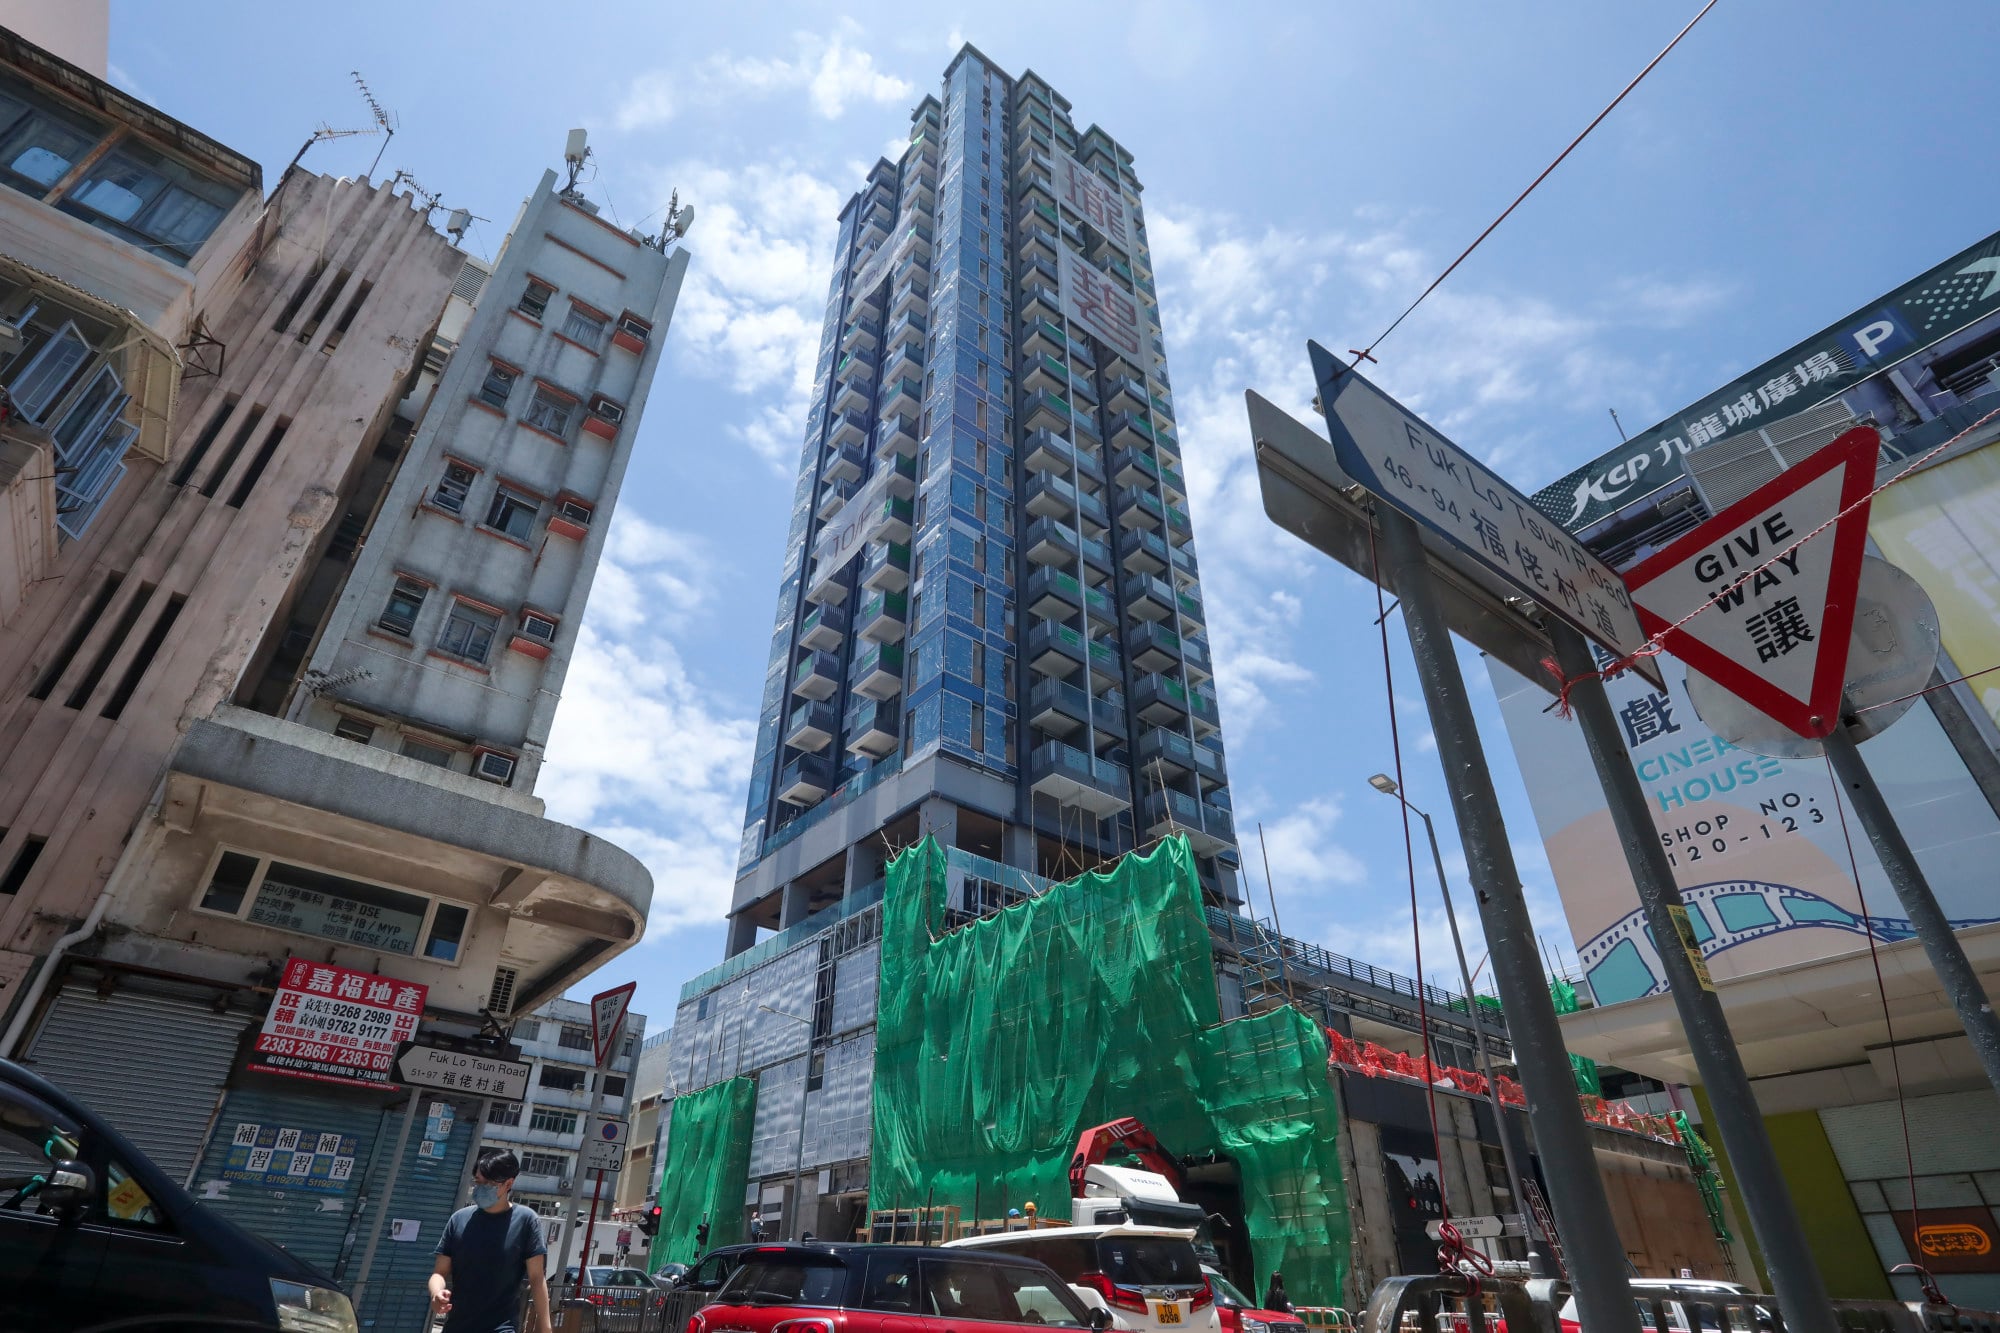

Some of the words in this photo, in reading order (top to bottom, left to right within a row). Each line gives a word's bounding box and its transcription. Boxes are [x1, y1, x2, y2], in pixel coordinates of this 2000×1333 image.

[1853, 320, 1895, 358] P
[1563, 453, 1651, 527] KCP
[1654, 350, 1840, 467] 九龍城廣場
[1404, 421, 1461, 483] Fuk
[1466, 465, 1504, 512] Lo
[1507, 496, 1570, 563] Tsun
[1571, 545, 1630, 612] Road
[1383, 455, 1462, 522] 46-94
[1469, 508, 1622, 646] 福佬村道
[1694, 511, 1794, 583] GIVE
[1708, 546, 1800, 614] WAY
[1745, 595, 1815, 664] 讓
[1619, 690, 1684, 749] 戲
[1656, 754, 1784, 813] HOUSE
[1661, 814, 1729, 847] SHOP
[1759, 792, 1815, 817] NO.
[358, 904, 382, 919] DSE
[350, 930, 383, 945] IGCSE
[390, 937, 411, 950] GCE
[377, 921, 401, 935] MYP
[306, 967, 422, 1012] 嘉福地產
[602, 996, 618, 1011] GIVE
[331, 1003, 361, 1019] 9268
[363, 1010, 392, 1025] 2989
[601, 1008, 616, 1022] WAY
[326, 1018, 356, 1035] 9782
[358, 1024, 388, 1040] 9177
[390, 1015, 414, 1043] 出租
[260, 1036, 295, 1055] 2383
[295, 1042, 329, 1060] 2866
[338, 1051, 368, 1066] 2383
[428, 1051, 449, 1065] Fuk
[452, 1056, 467, 1067] Lo
[471, 1059, 495, 1073] Tsun
[498, 1063, 526, 1078] Road
[411, 1068, 438, 1080] 51-97
[442, 1071, 506, 1095] 福佬村道
[611, 1145, 618, 1154] 7
[609, 1160, 620, 1170] 12
[1130, 1177, 1163, 1187] VOLVO
